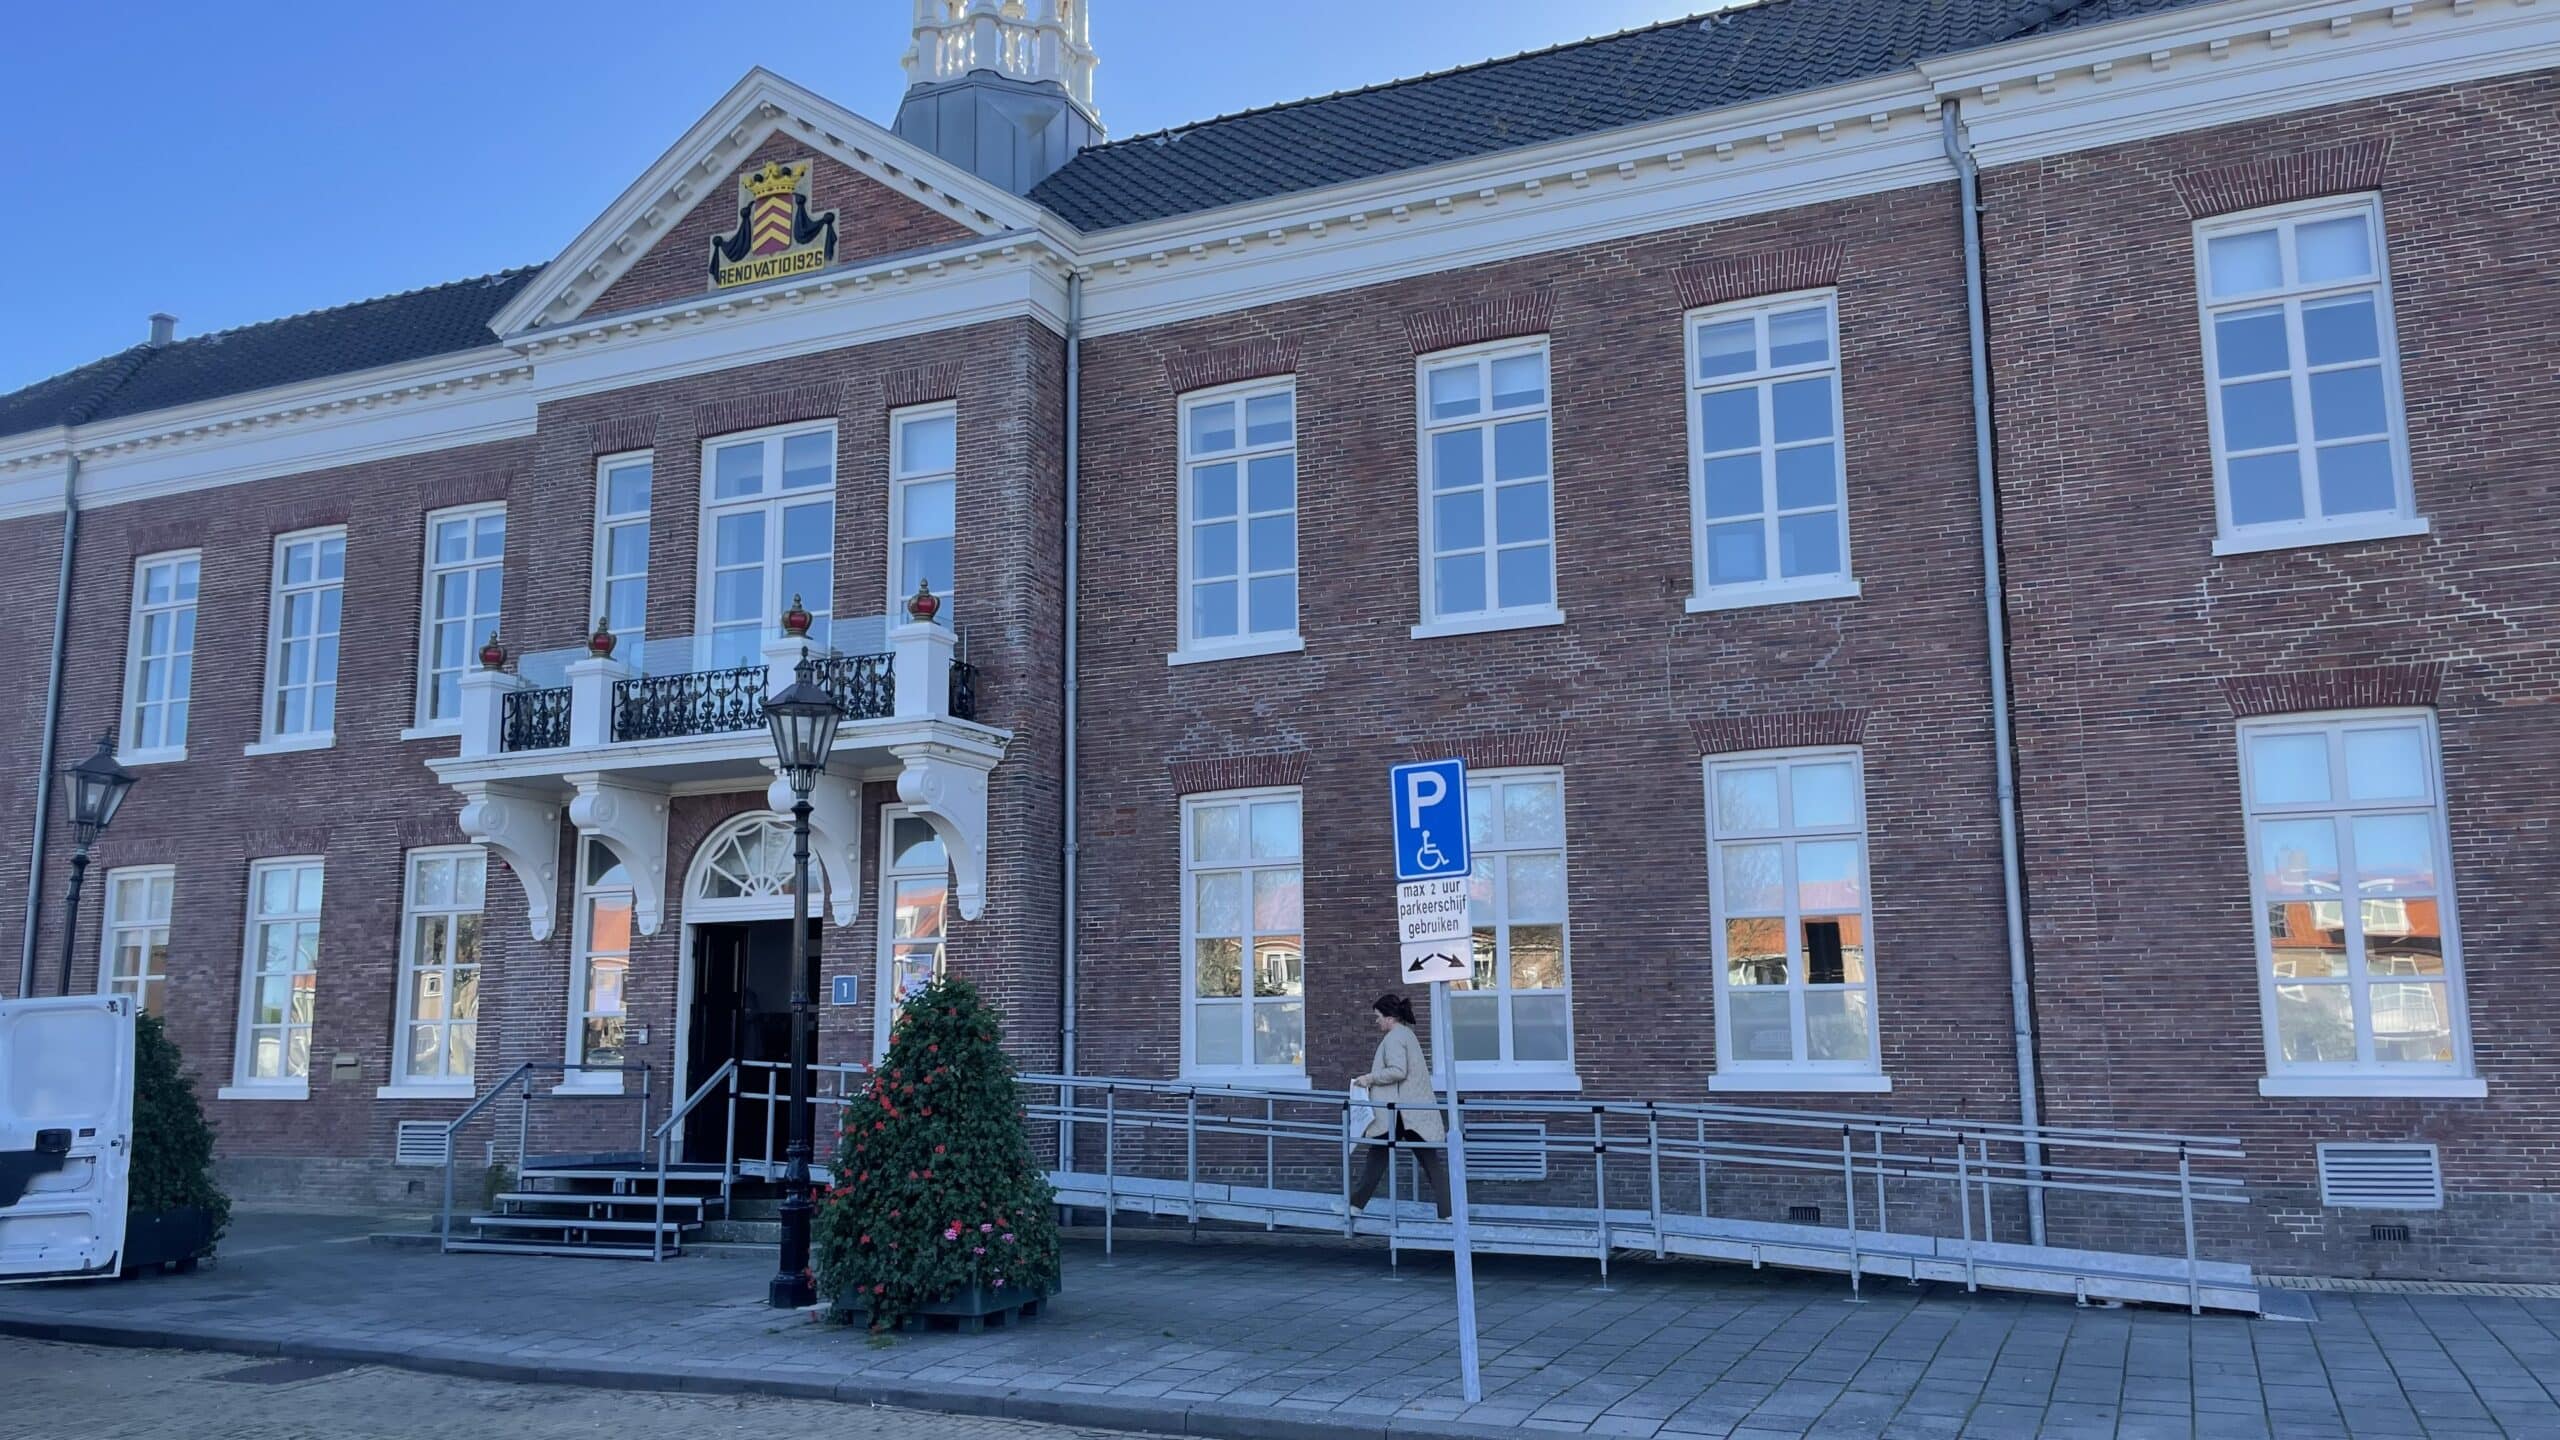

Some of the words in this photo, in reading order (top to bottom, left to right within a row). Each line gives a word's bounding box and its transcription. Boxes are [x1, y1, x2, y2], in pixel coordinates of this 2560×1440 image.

[719, 259, 791, 285] RENOVATIO
[793, 250, 823, 270] 1926
[1407, 771, 1447, 829] P
[1403, 884, 1425, 897] max
[1430, 883, 1436, 895] 2
[1442, 879, 1460, 894] uur
[1400, 895, 1466, 919] parkeerschijf
[1408, 917, 1459, 938] gebruiken
[842, 982, 847, 998] 1
